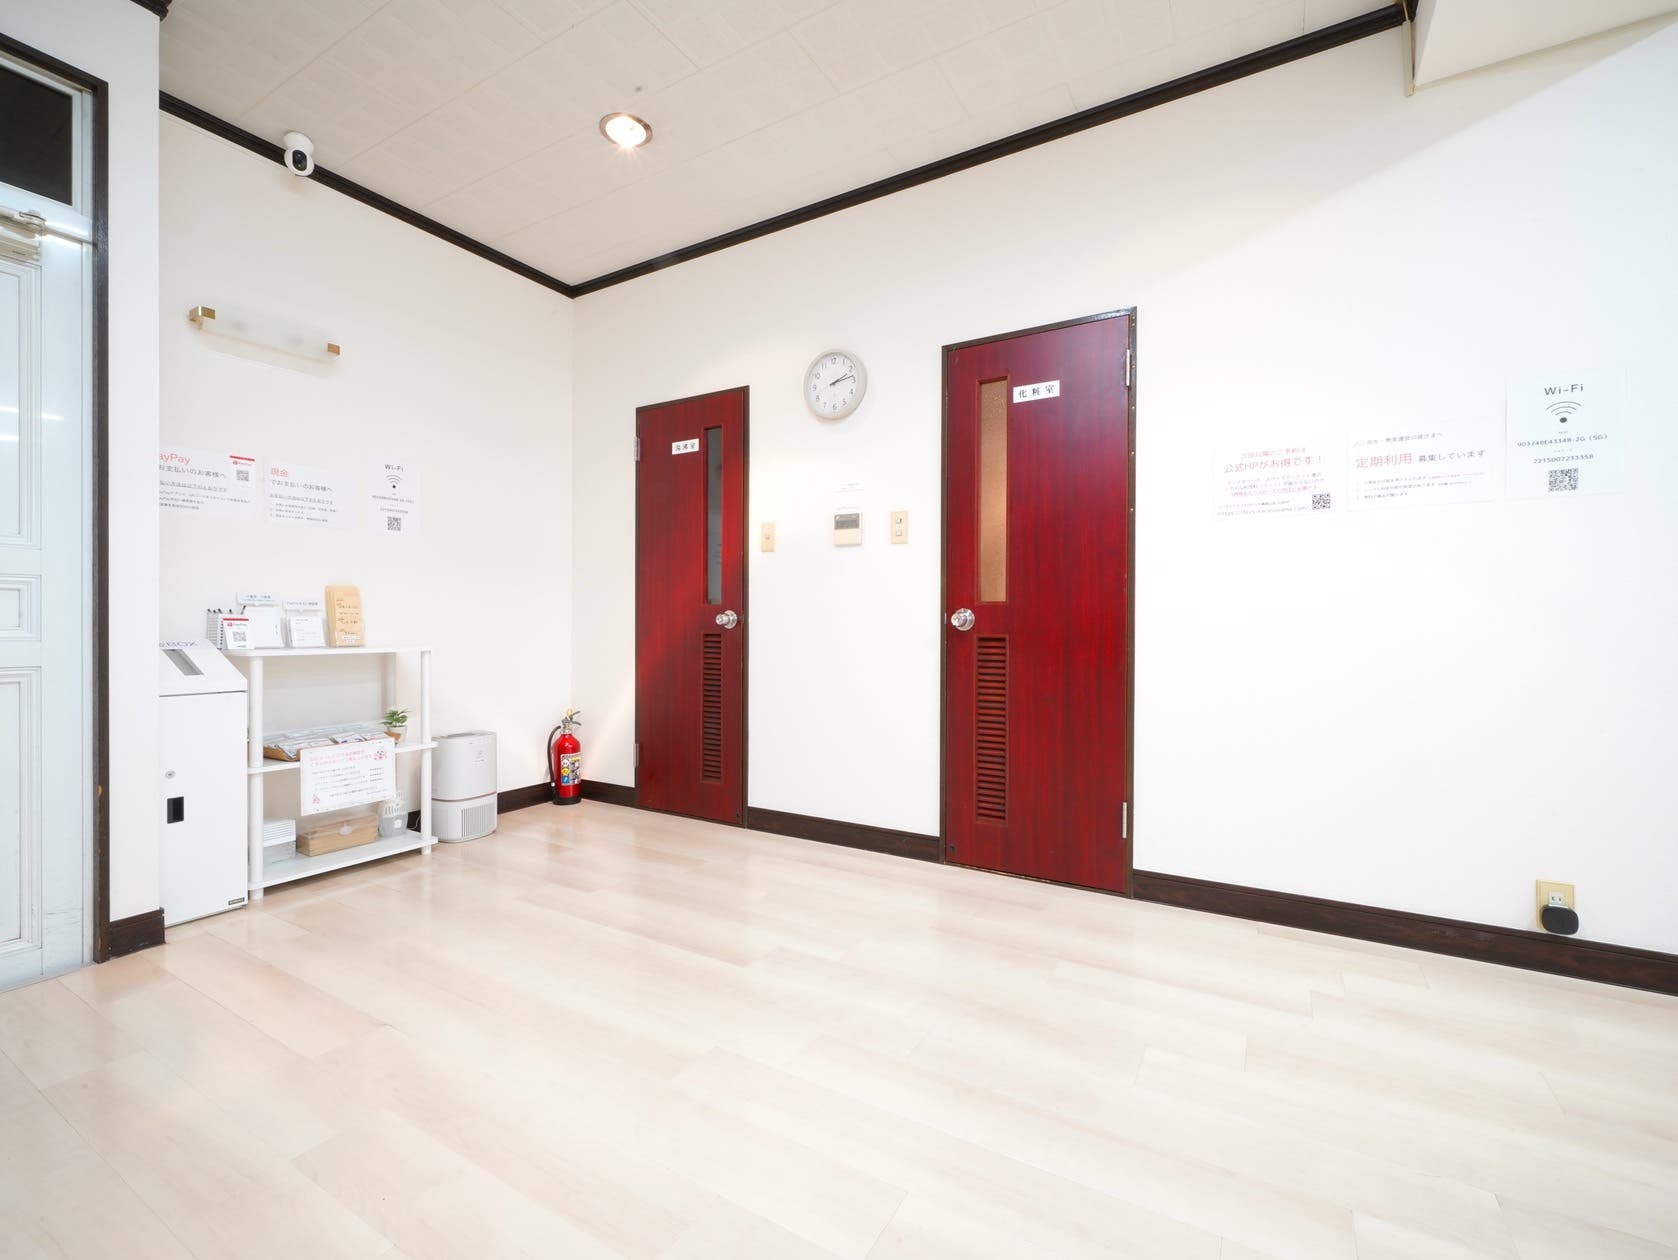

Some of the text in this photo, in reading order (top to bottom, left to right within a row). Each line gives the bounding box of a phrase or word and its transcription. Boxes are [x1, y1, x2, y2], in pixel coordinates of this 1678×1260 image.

[1018, 384, 1055, 399] 化粧室
[1544, 383, 1584, 396] Wi-Fi
[1355, 449, 1486, 469] 定期利用 募集しています
[271, 467, 288, 478] 現金
